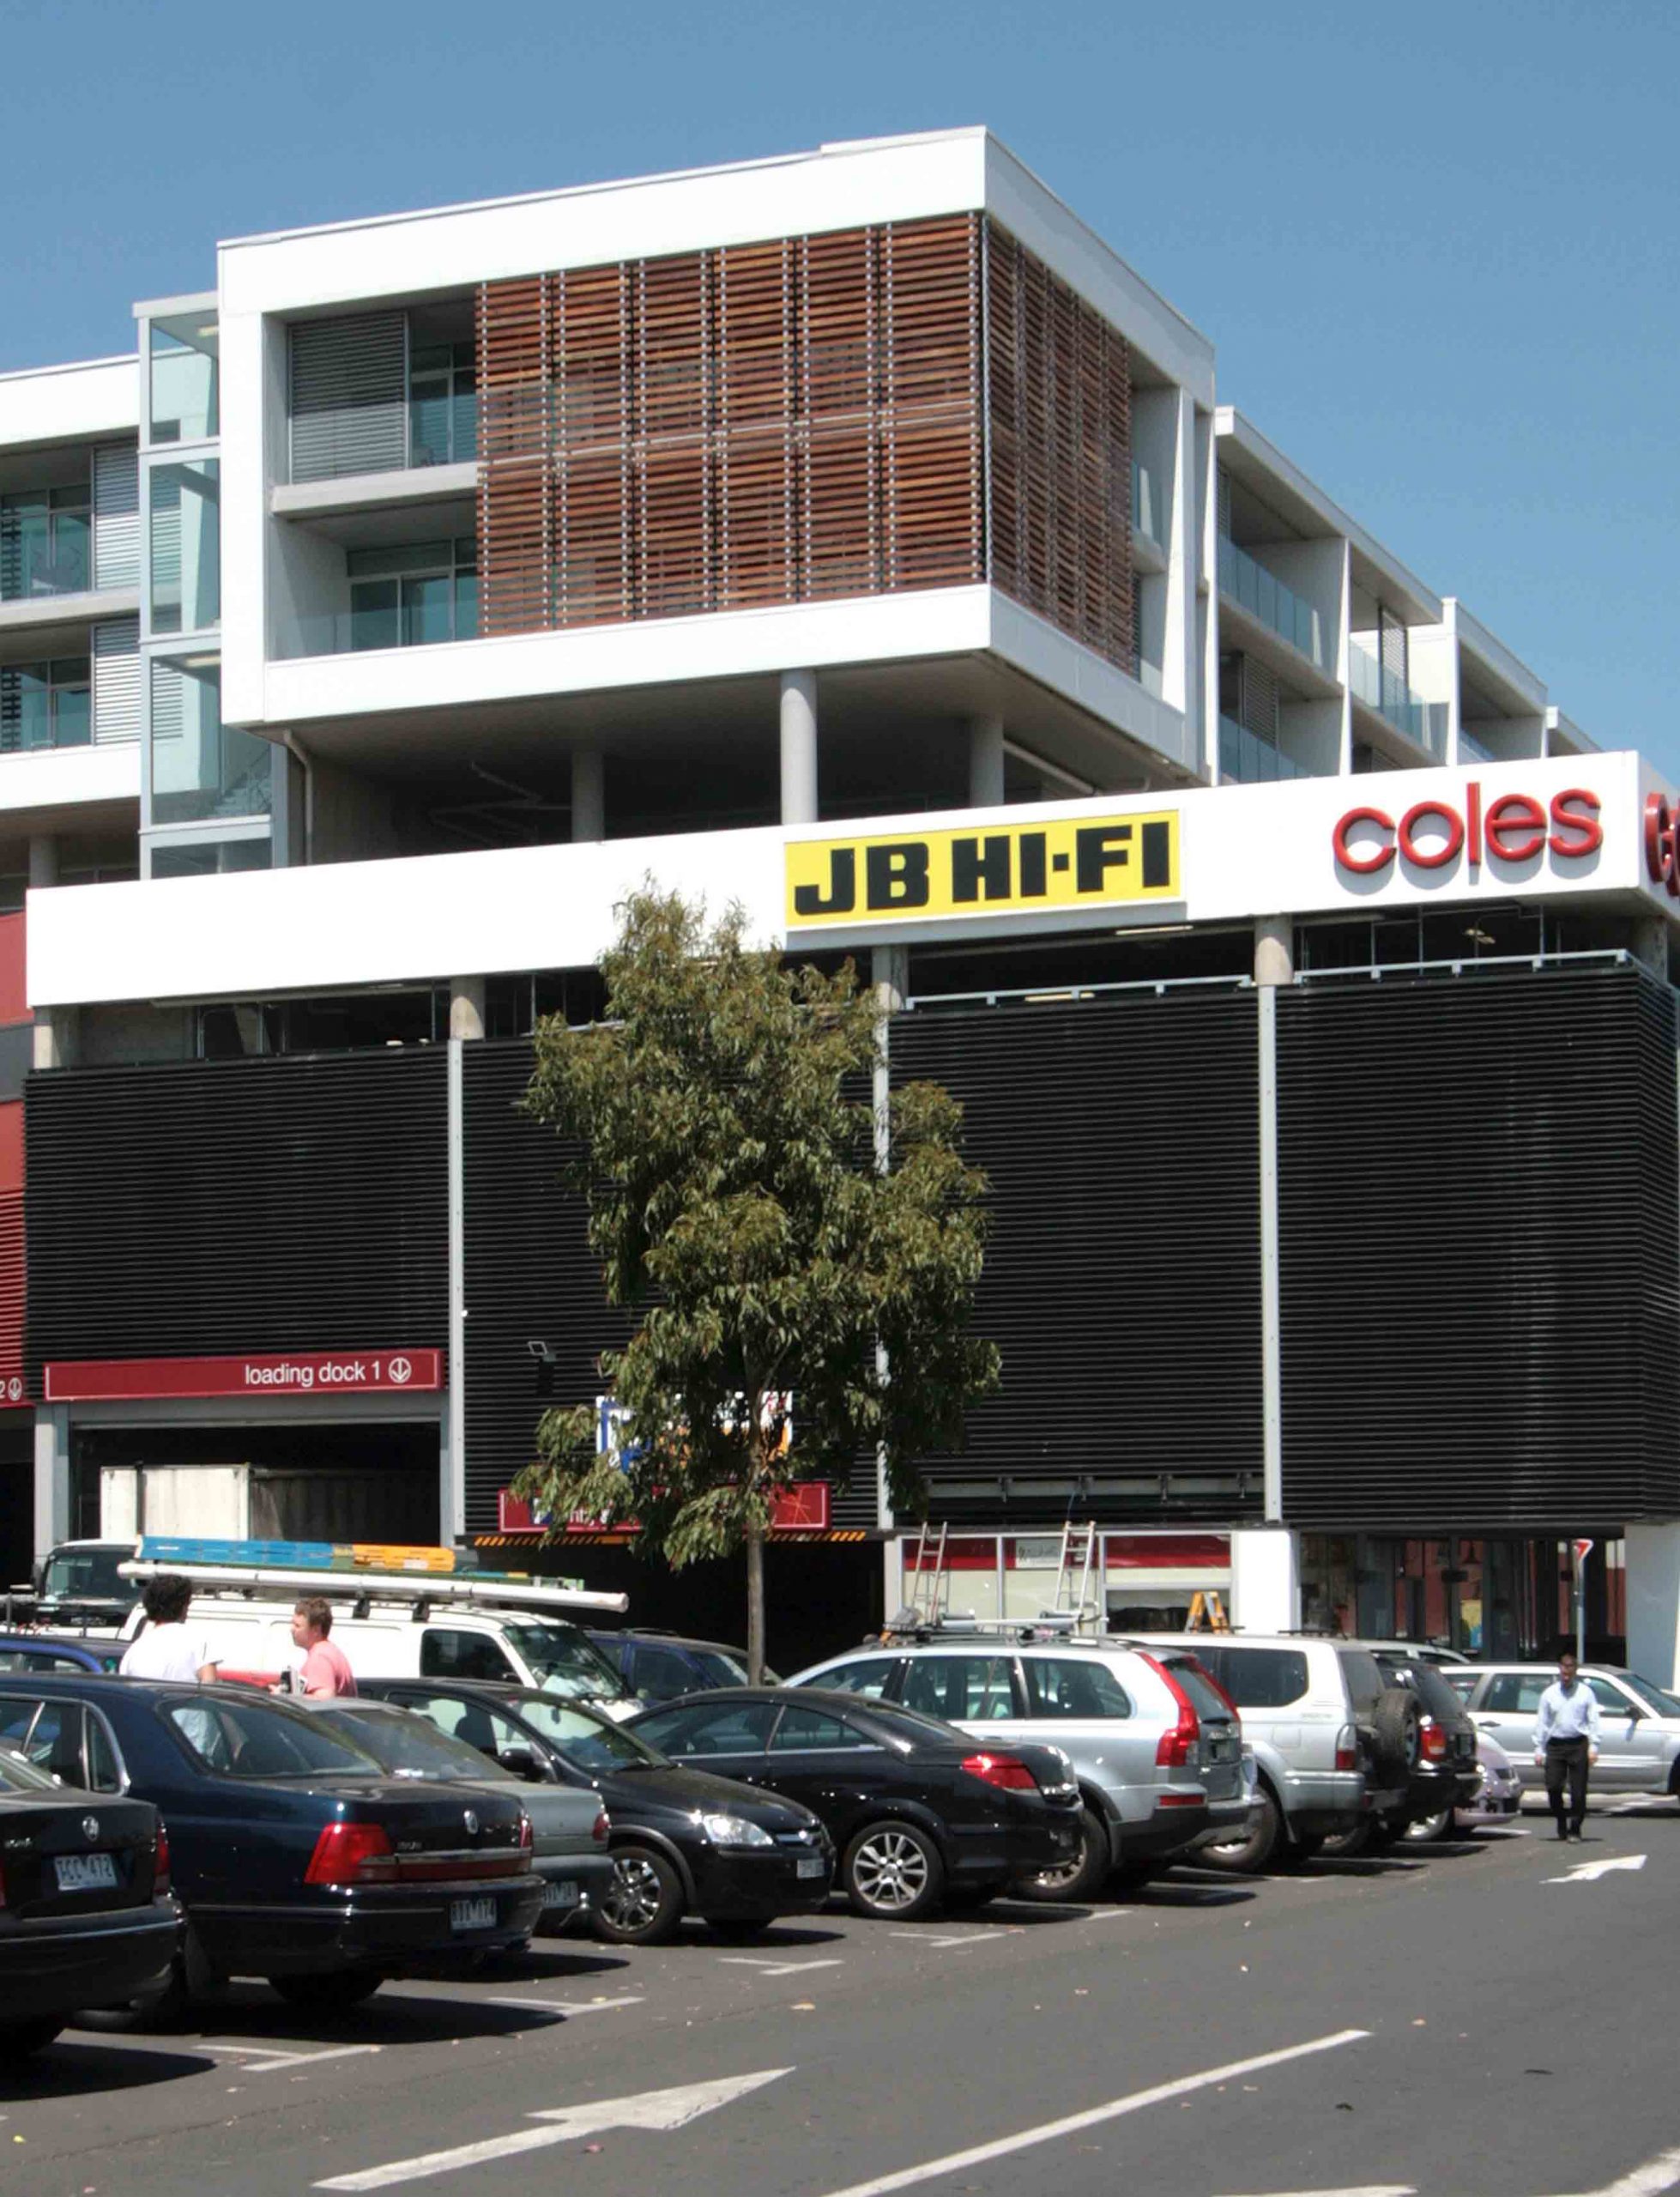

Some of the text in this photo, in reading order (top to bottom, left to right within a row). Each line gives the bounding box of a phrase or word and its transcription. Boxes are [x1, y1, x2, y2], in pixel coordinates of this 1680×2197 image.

[794, 821, 1170, 916] JB HI-FI
[1332, 782, 1604, 874] coles
[245, 1360, 380, 1387] loading dock 1
